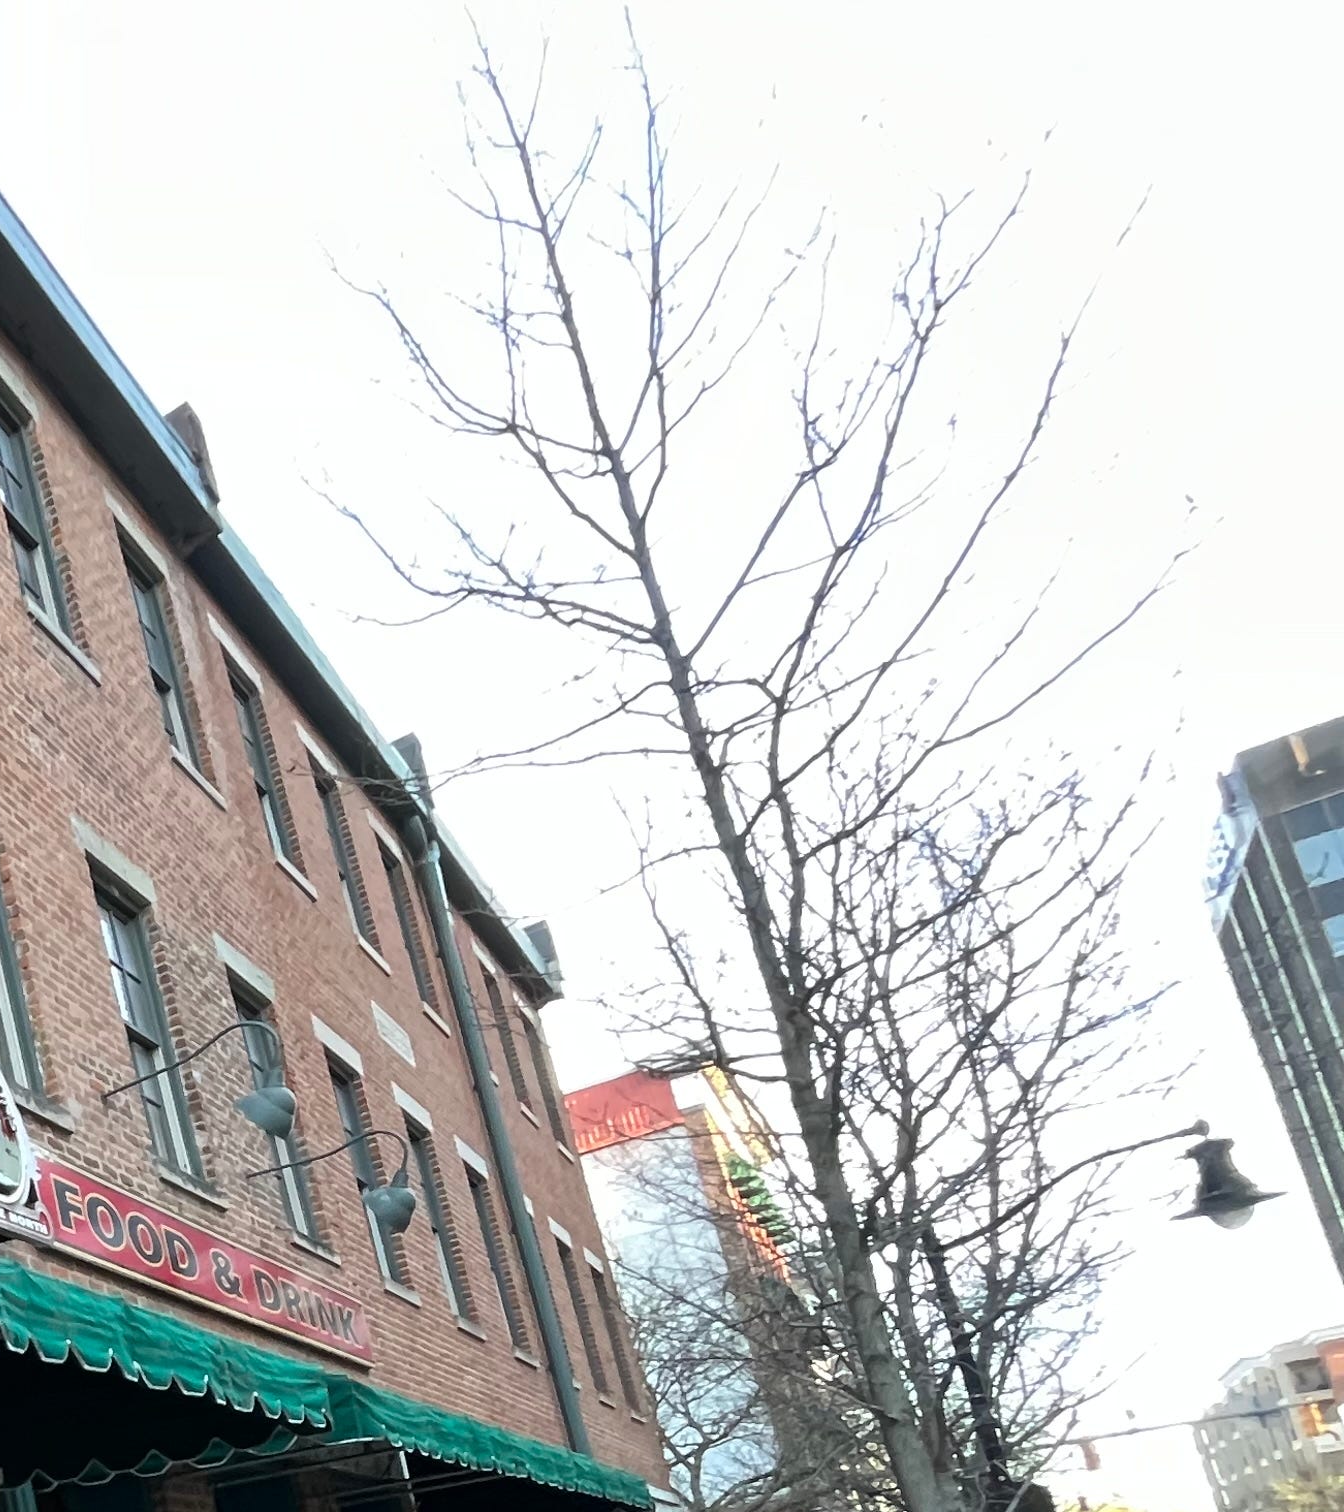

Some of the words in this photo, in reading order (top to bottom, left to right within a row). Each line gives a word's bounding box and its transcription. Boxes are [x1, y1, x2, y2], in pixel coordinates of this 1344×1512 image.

[9, 1211, 48, 1235] NORTH
[50, 1172, 199, 1281] FOOD
[210, 1248, 248, 1303] &
[250, 1263, 363, 1349] DRINK
